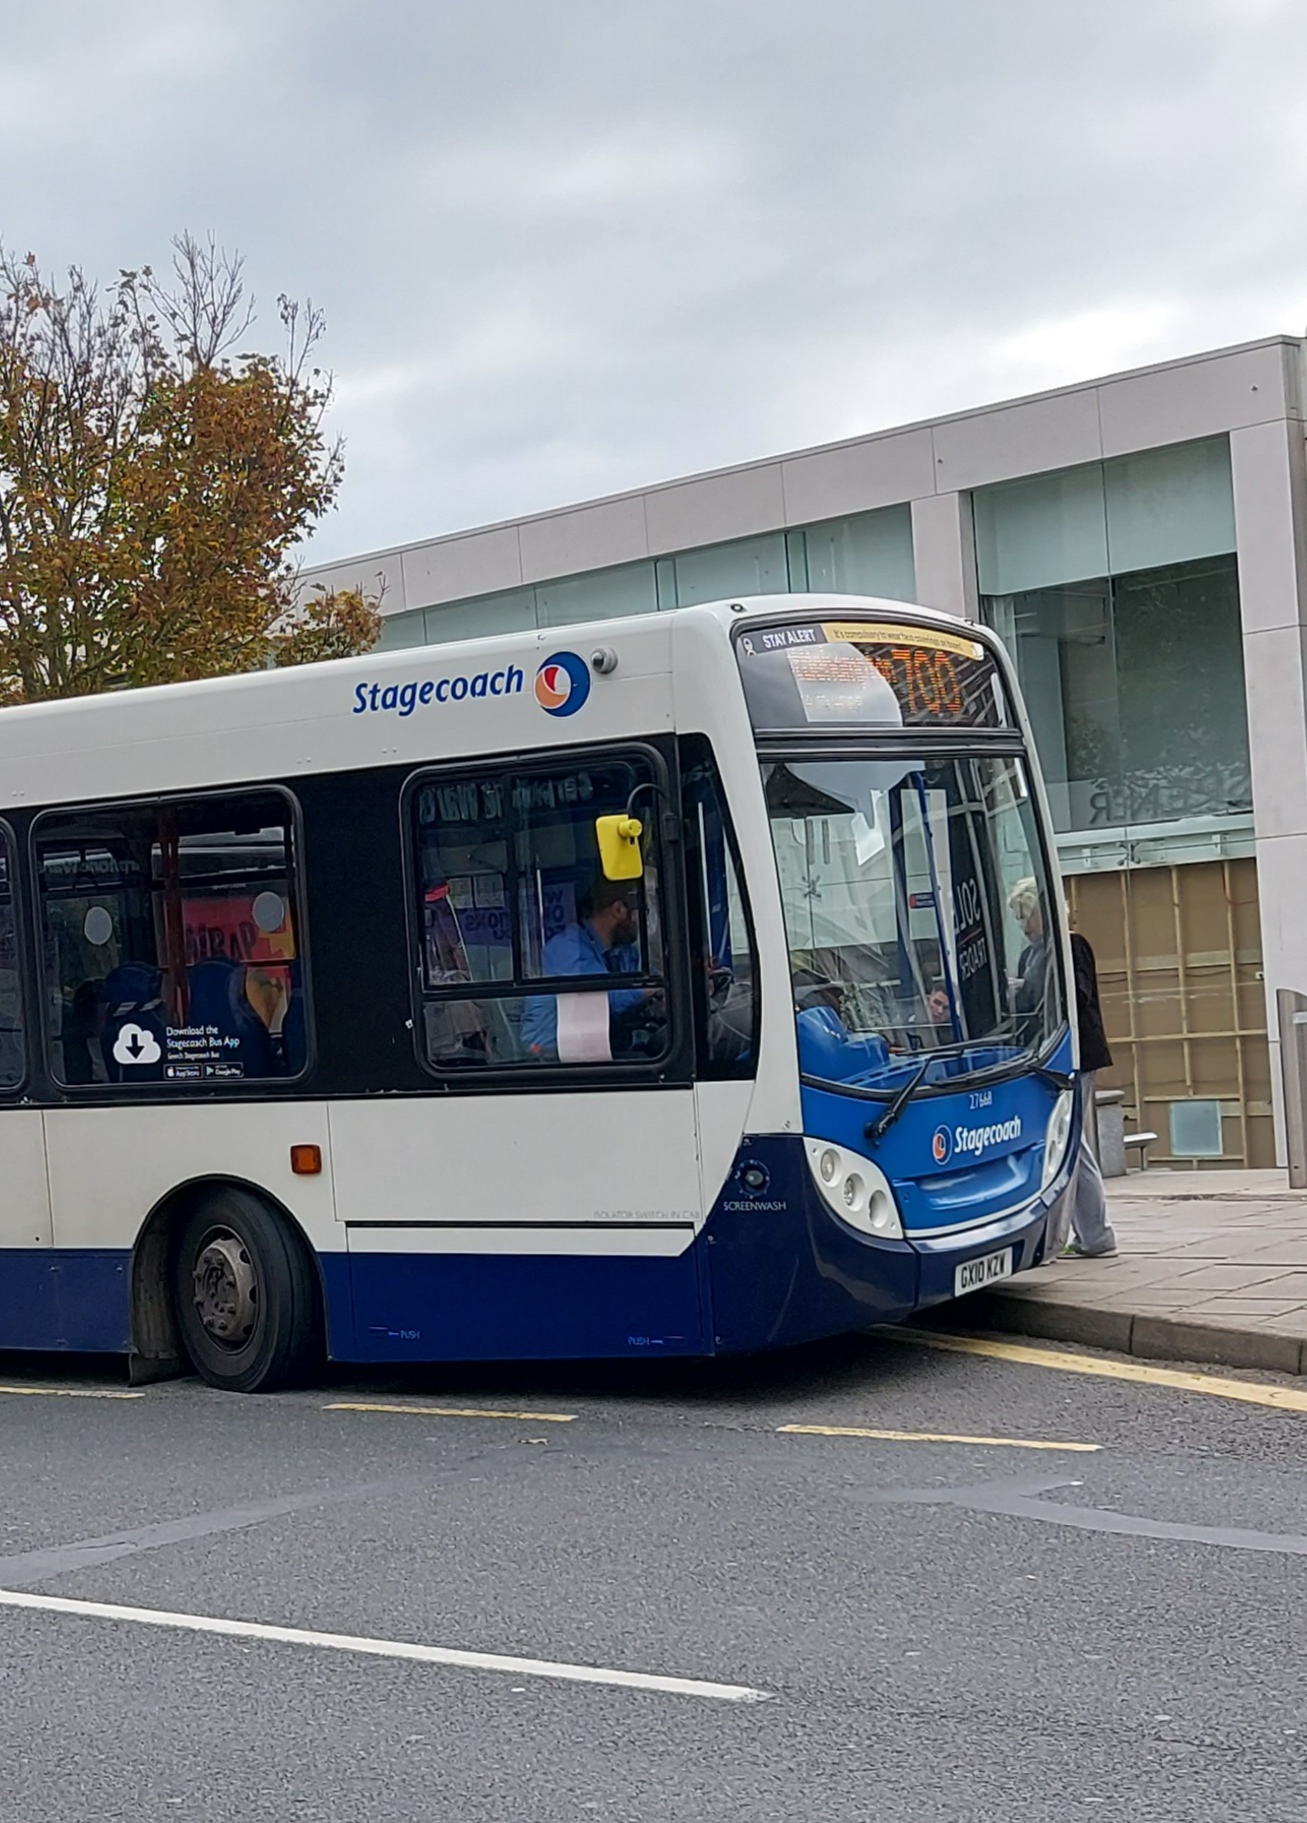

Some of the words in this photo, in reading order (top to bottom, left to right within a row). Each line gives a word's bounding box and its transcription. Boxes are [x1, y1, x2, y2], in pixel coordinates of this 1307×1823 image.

[762, 631, 787, 649] STAY
[787, 628, 817, 645] ALERT
[891, 648, 961, 714] 700
[351, 664, 524, 717] Stagecoach
[166, 1025, 204, 1036] Download
[205, 1024, 219, 1035] the
[166, 1037, 208, 1050] Stagecoach
[209, 1036, 223, 1047] Bus
[223, 1035, 240, 1048] App
[954, 1114, 1021, 1156] Stagecoach
[723, 1201, 787, 1211] SCREENWASH
[961, 1260, 984, 1289] GX10
[400, 1330, 420, 1340] PUSH
[628, 1337, 650, 1346] PUSH
